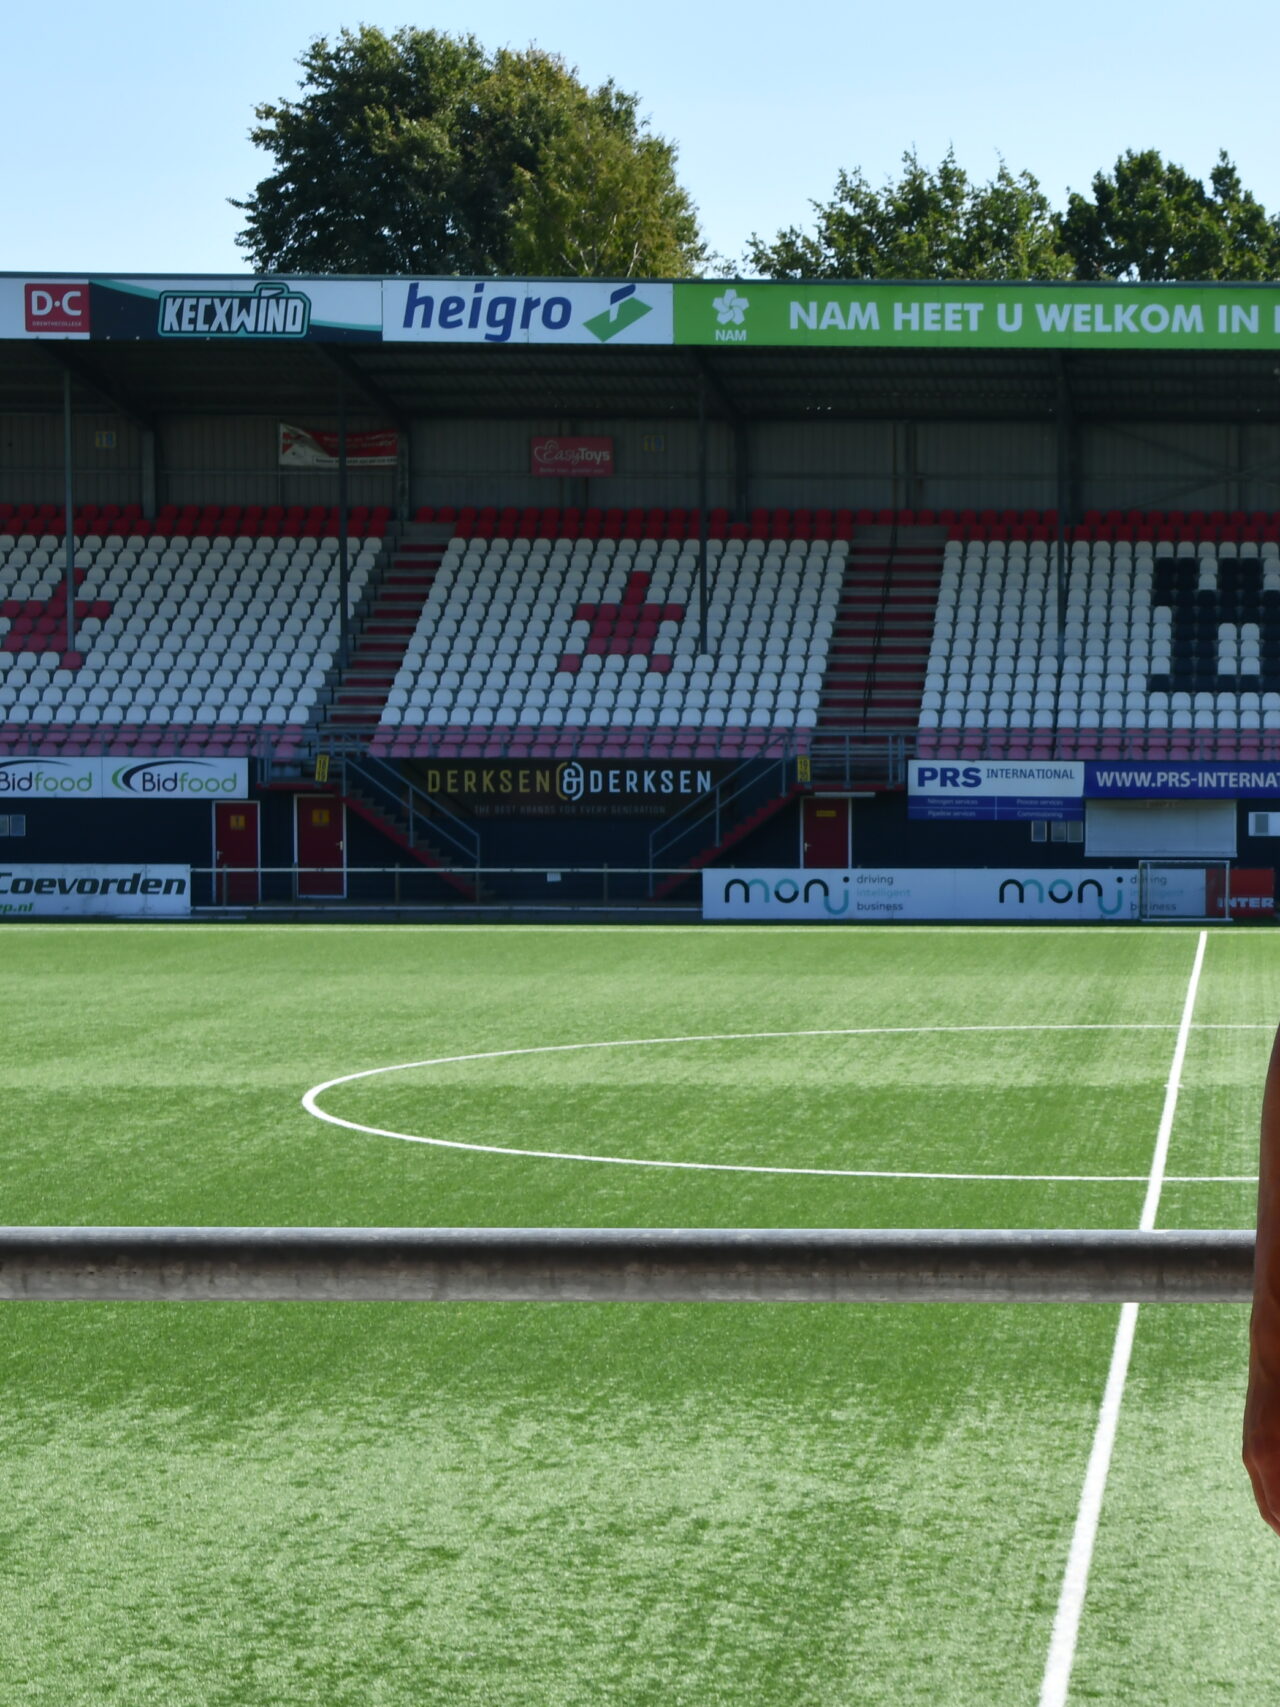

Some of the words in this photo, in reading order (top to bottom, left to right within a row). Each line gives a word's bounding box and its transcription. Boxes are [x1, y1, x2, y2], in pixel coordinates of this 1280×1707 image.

[402, 282, 572, 342] heigro
[790, 301, 880, 330] NAM
[894, 303, 984, 332] HEET
[997, 303, 1023, 332] U
[1036, 304, 1204, 333] WELKOM
[1218, 305, 1259, 334] IN
[715, 329, 747, 342] NAM
[0, 771, 92, 792] Bidfood
[142, 771, 237, 793] Bidfood
[427, 769, 550, 793] DERKSEN
[589, 769, 712, 793] DERKSEN
[918, 767, 982, 787] PRS
[986, 768, 1075, 780] INTERNATIONAL
[857, 875, 894, 886] driving
[857, 888, 911, 900] intelligent
[857, 901, 904, 911] business
